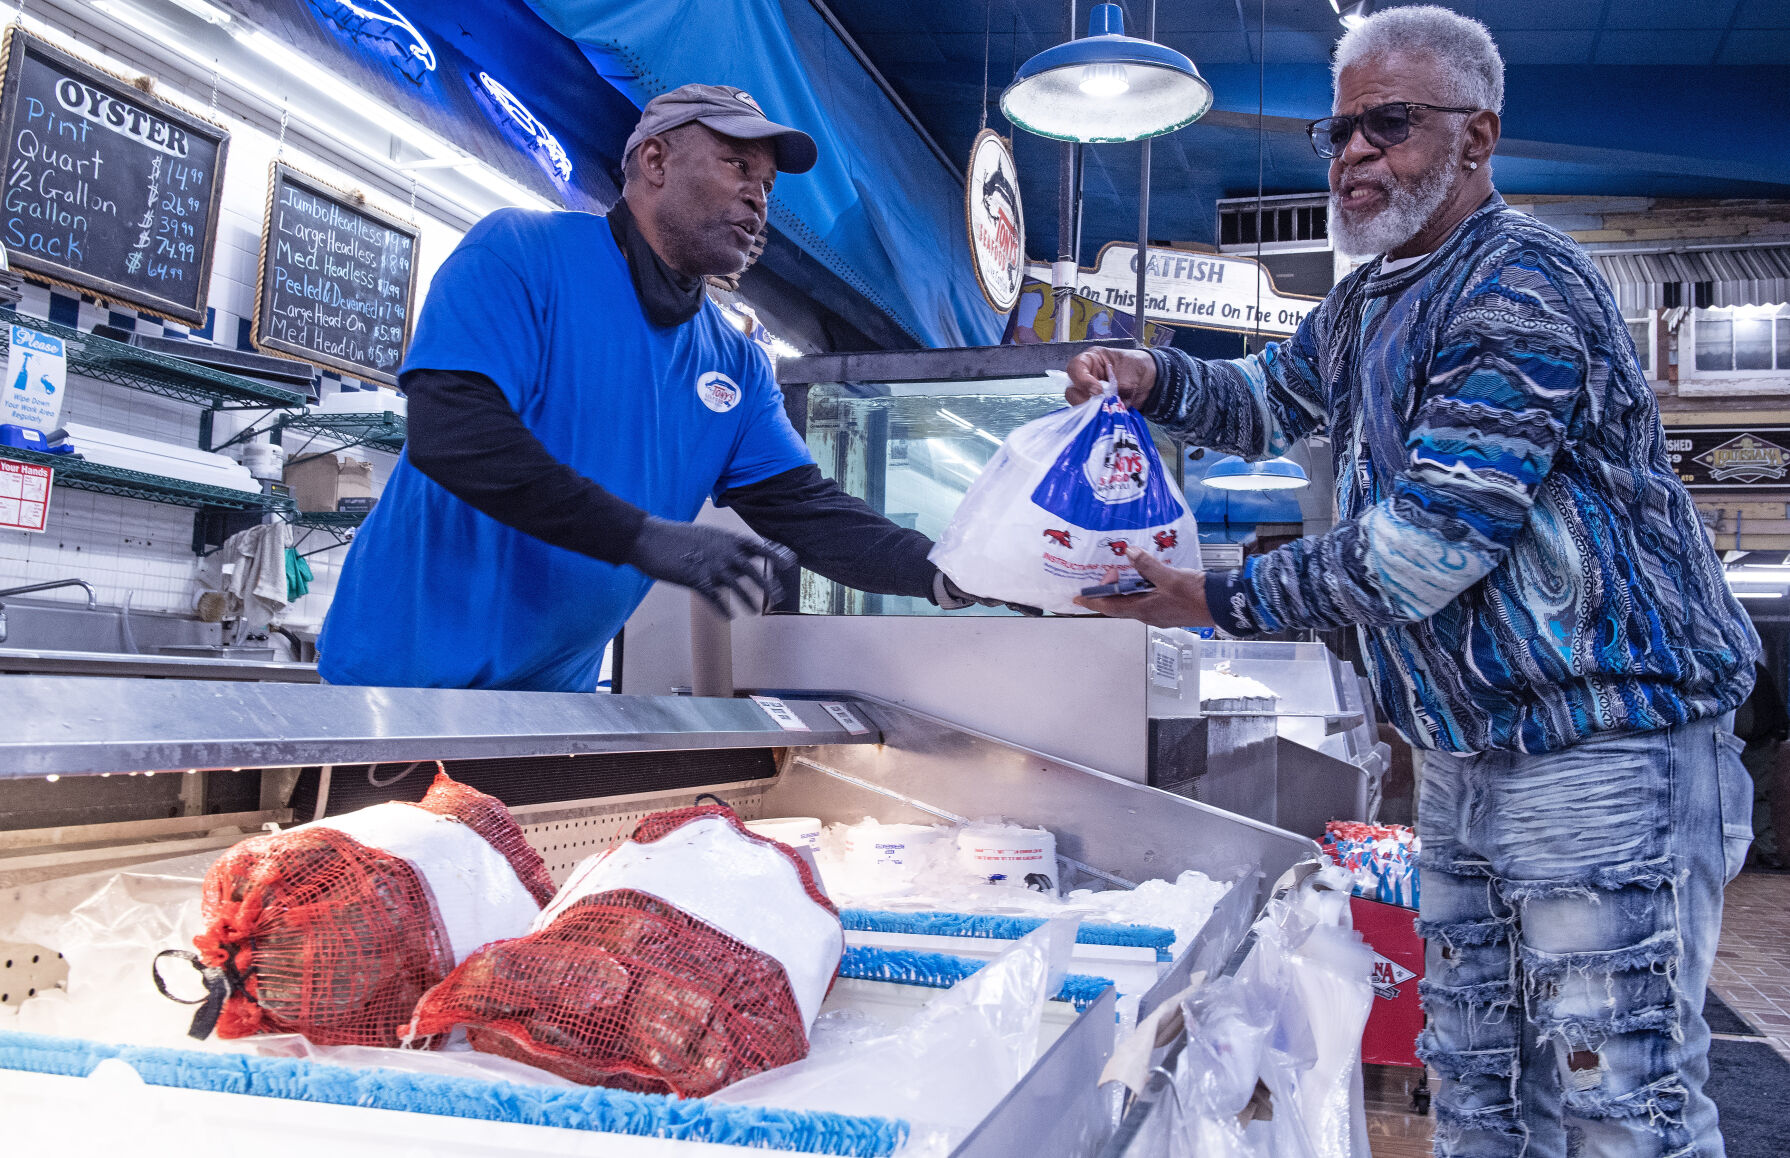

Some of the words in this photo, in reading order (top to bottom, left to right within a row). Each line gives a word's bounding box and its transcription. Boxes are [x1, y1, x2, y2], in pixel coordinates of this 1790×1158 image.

[25, 97, 93, 142] Pint
[57, 79, 188, 157] OYSTER
[17, 129, 103, 180] Quart
[6, 187, 87, 232] Gallon
[40, 169, 117, 216] Gallon
[5, 217, 83, 262] Sack
[279, 211, 327, 252] Large
[328, 228, 377, 267] Headless
[979, 224, 1006, 271] SEAFOOD
[324, 254, 375, 288] Headless
[273, 292, 312, 326] Large
[1080, 285, 1100, 301] On
[1105, 287, 1135, 307] This
[1176, 296, 1216, 317] Fried
[1221, 303, 1241, 320] On
[1246, 305, 1271, 323] The
[1278, 309, 1304, 327] Oth
[16, 328, 60, 354] Please
[271, 315, 307, 346] Med
[0, 461, 20, 473] Your
[21, 465, 48, 478] Hands
